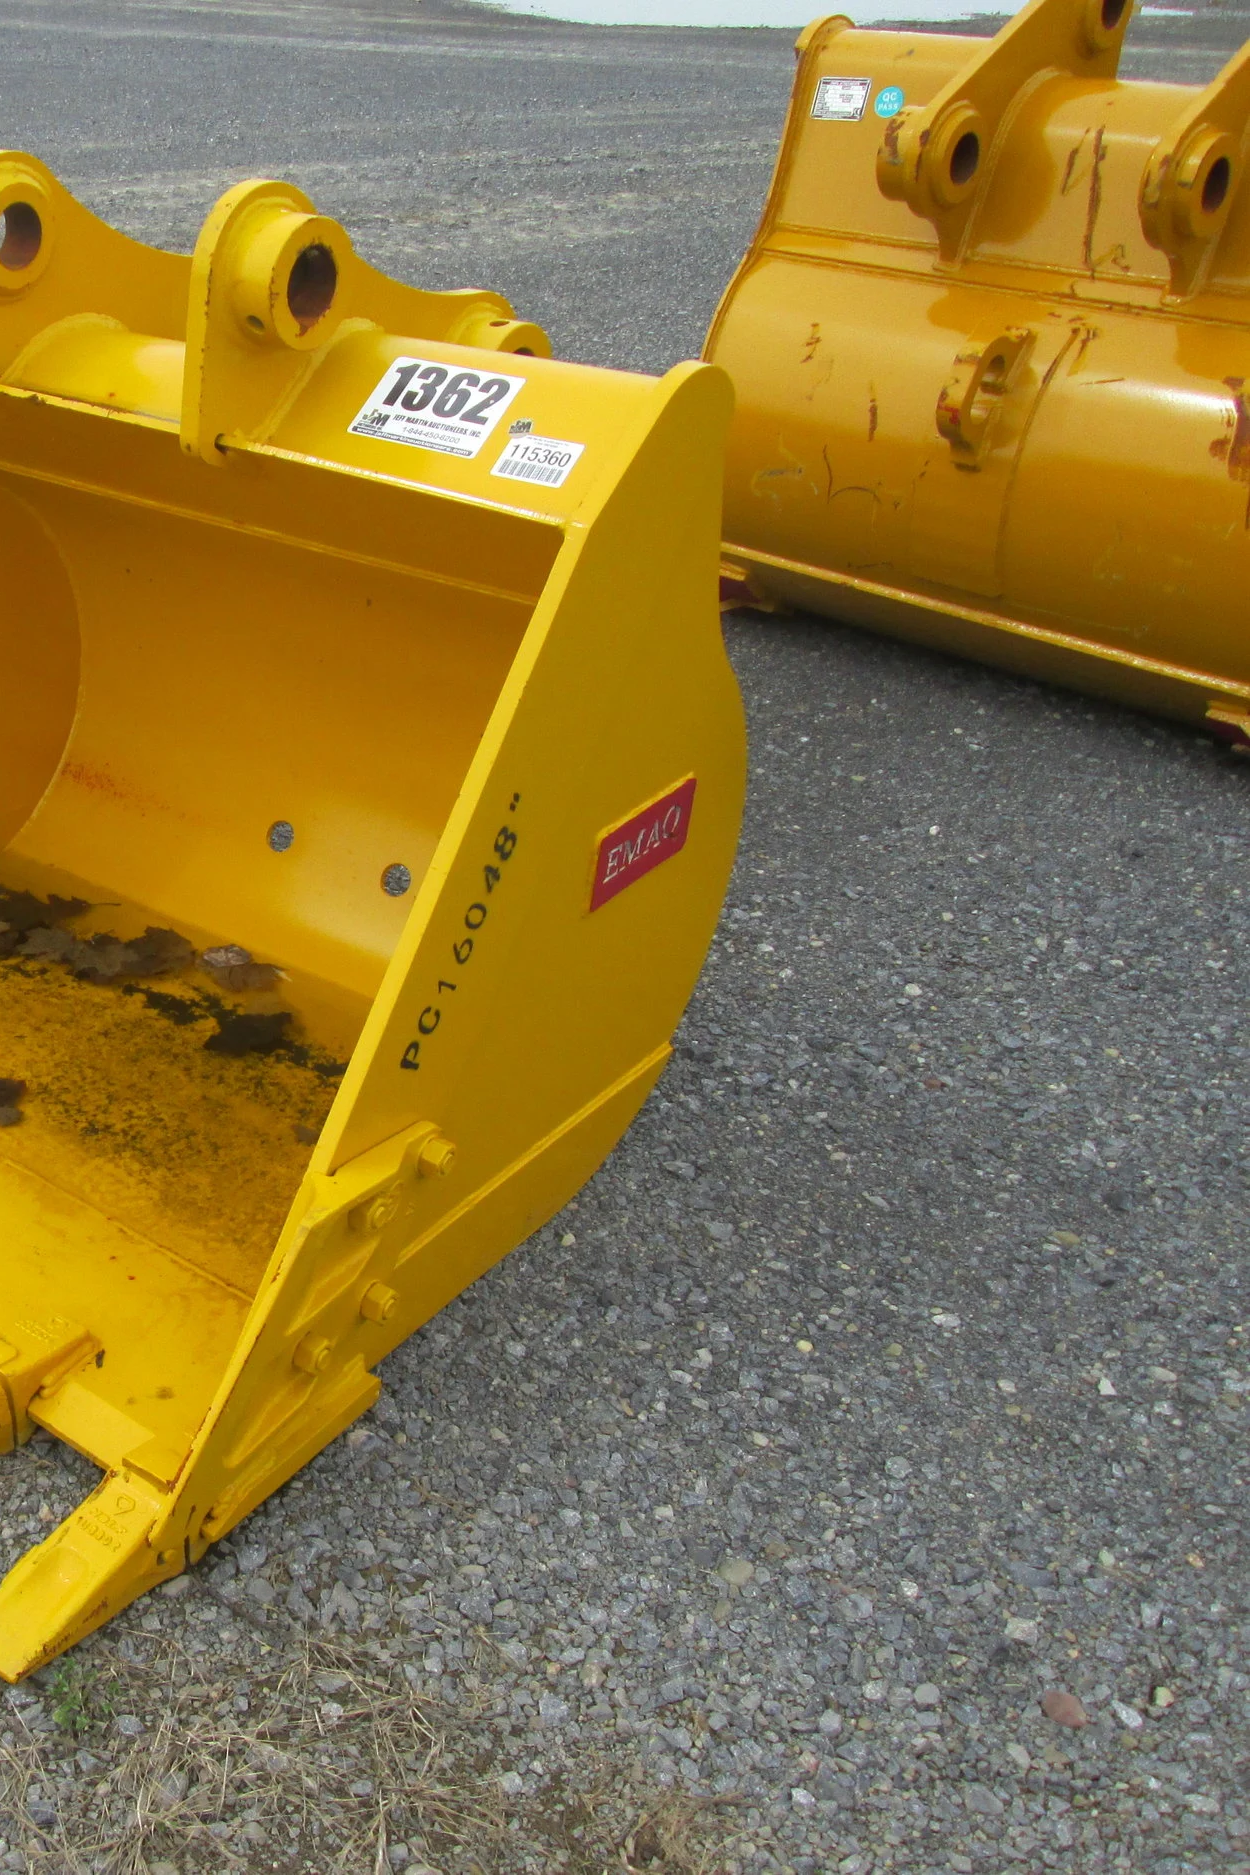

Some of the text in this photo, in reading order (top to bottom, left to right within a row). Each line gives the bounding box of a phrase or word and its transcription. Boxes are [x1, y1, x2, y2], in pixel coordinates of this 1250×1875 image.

[882, 92, 898, 102] QC
[877, 103, 899, 111] PASS
[382, 363, 511, 425] 1362
[392, 414, 406, 422] JEFF
[405, 416, 428, 427] MARTIN
[402, 426, 461, 444] 1-844-450-6200
[511, 443, 572, 468] 115360
